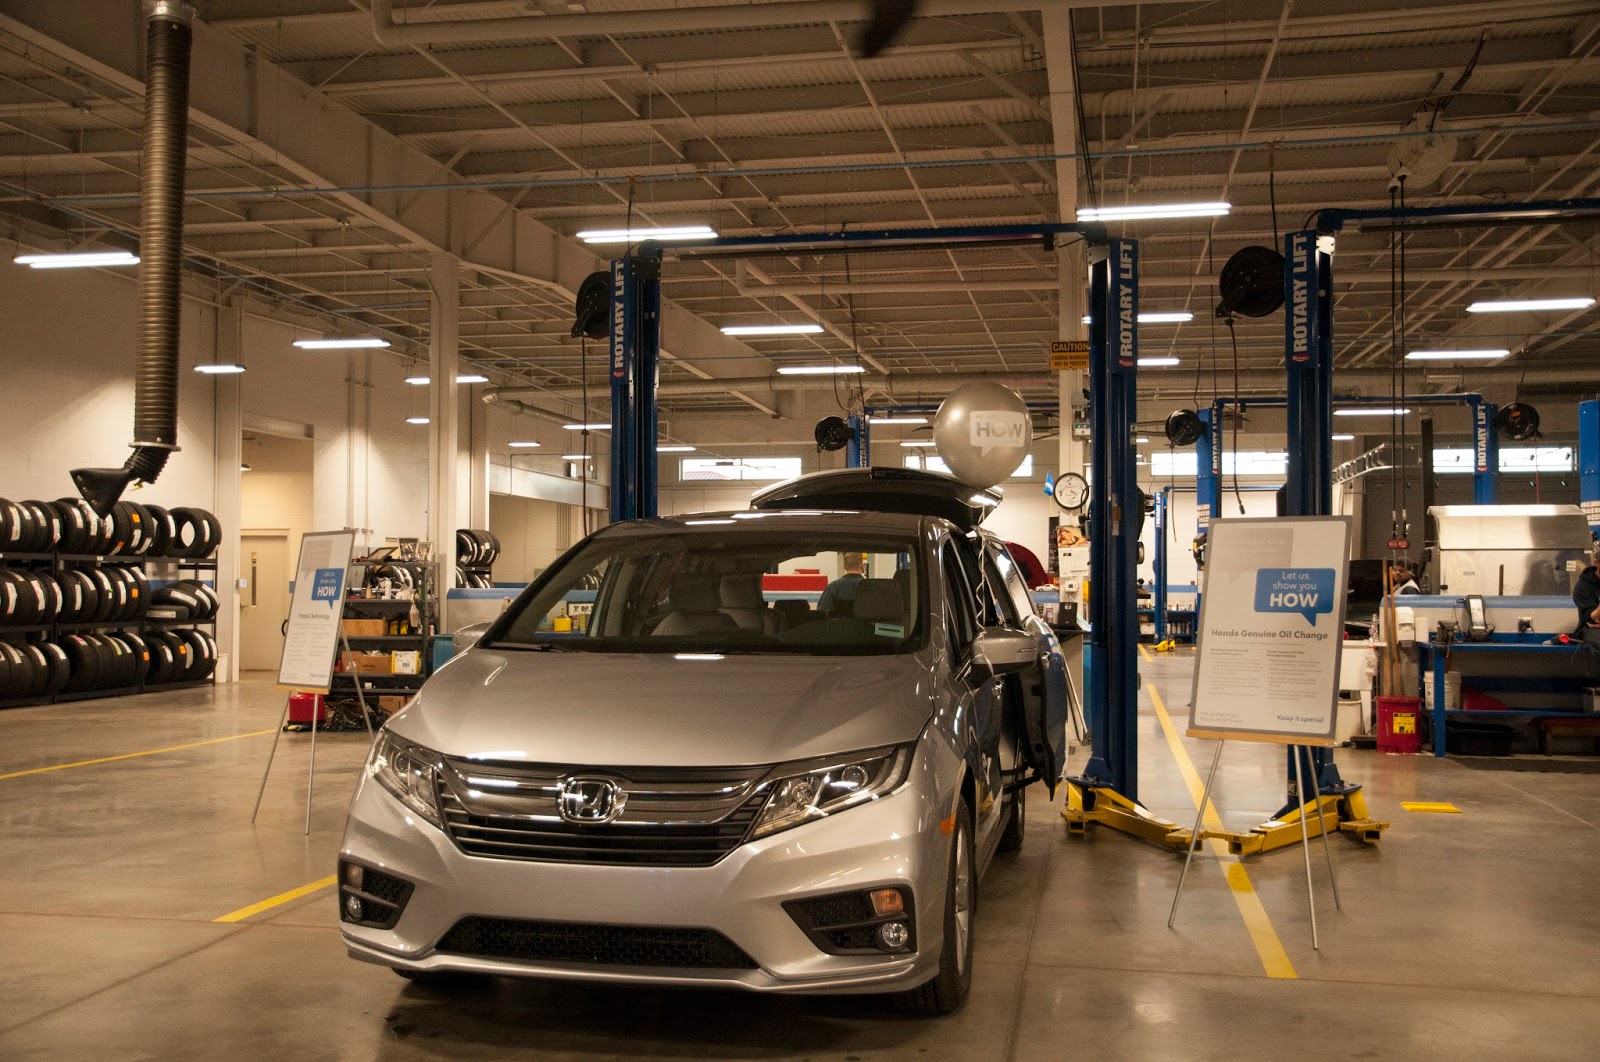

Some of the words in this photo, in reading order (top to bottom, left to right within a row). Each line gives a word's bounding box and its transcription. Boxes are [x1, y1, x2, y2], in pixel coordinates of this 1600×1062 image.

[1119, 241, 1133, 280] LIFT
[1293, 234, 1308, 273] LIFT
[614, 260, 625, 297] LIFT
[1119, 284, 1133, 357] ROTARY
[1293, 279, 1308, 352] ROTARY
[614, 301, 625, 369] ROTARY
[1052, 342, 1089, 352] CAUTION
[1477, 404, 1486, 425] LIFT
[976, 422, 1022, 438] HOW
[1477, 427, 1487, 466] ROTARY
[1282, 571, 1297, 580] Let
[317, 586, 337, 597] HOW
[1272, 580, 1297, 590] show
[1299, 583, 1317, 592] you
[1269, 592, 1319, 608] HOW
[1211, 629, 1239, 637] Honda
[1240, 629, 1277, 638] Genuine
[1278, 630, 1292, 638] Oil
[1293, 631, 1329, 641] Change
[1276, 714, 1294, 722] Keep
[1300, 716, 1324, 724] special
